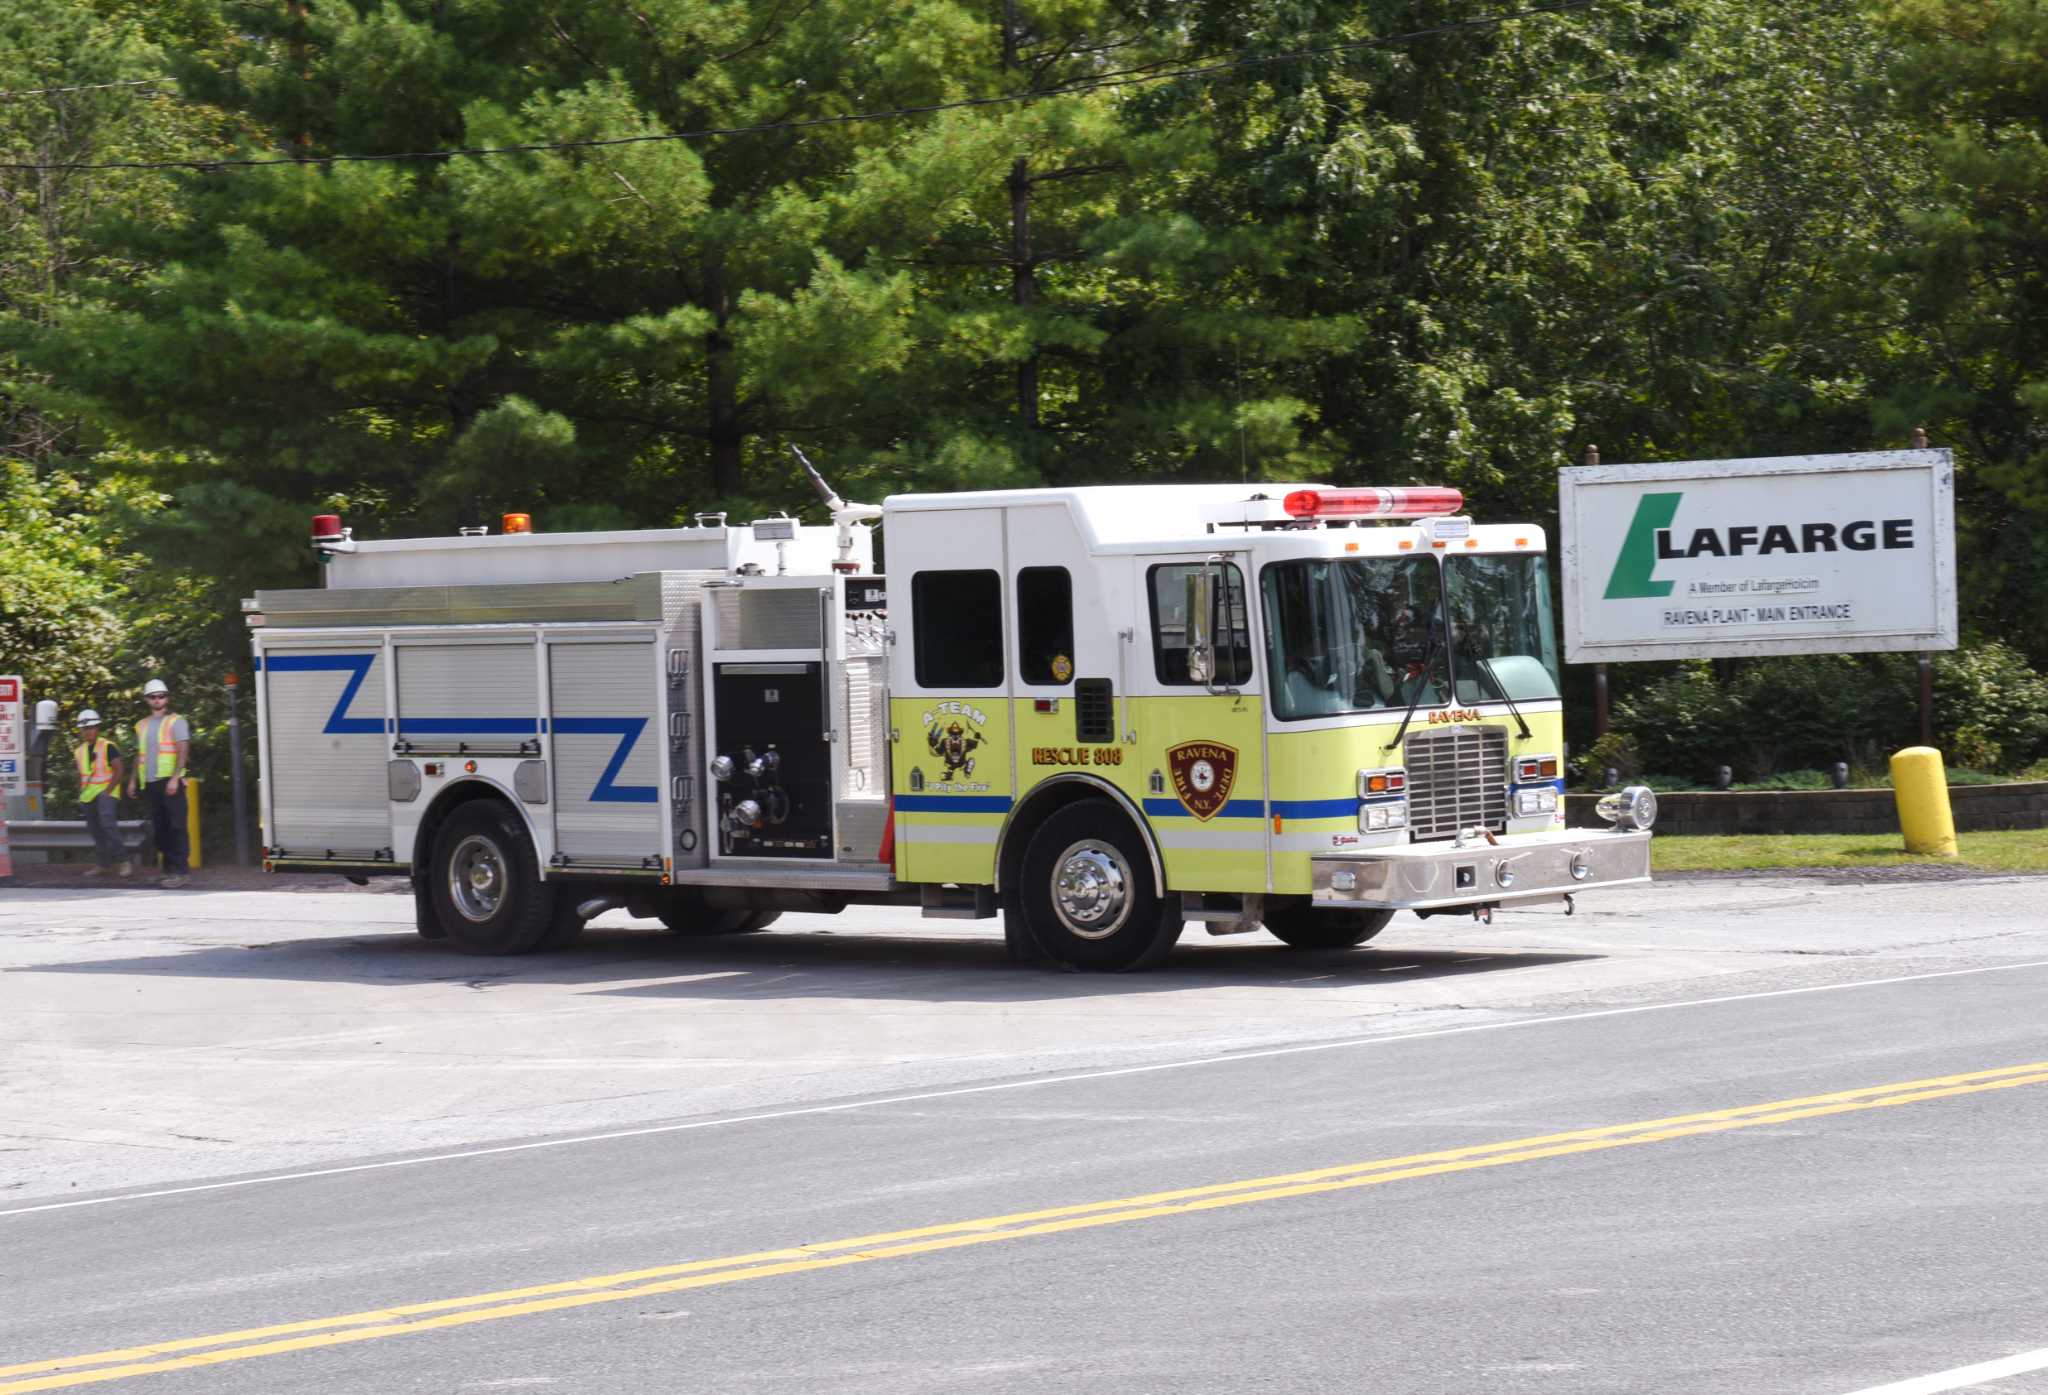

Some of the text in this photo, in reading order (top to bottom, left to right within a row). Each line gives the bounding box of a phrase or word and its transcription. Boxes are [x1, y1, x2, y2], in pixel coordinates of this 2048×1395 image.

[1657, 519, 1914, 560] LAFARGE
[1700, 580, 1737, 594] Member
[1739, 579, 1750, 592] of
[1664, 610, 1710, 626] RAVENA
[1712, 608, 1750, 624] PLANT
[1757, 606, 1785, 623] MAIN
[1789, 603, 1851, 621] ENTRANCE
[1428, 708, 1482, 724] RAVENA
[1032, 747, 1090, 766] RESCUE
[1176, 747, 1227, 761] RAVENA
